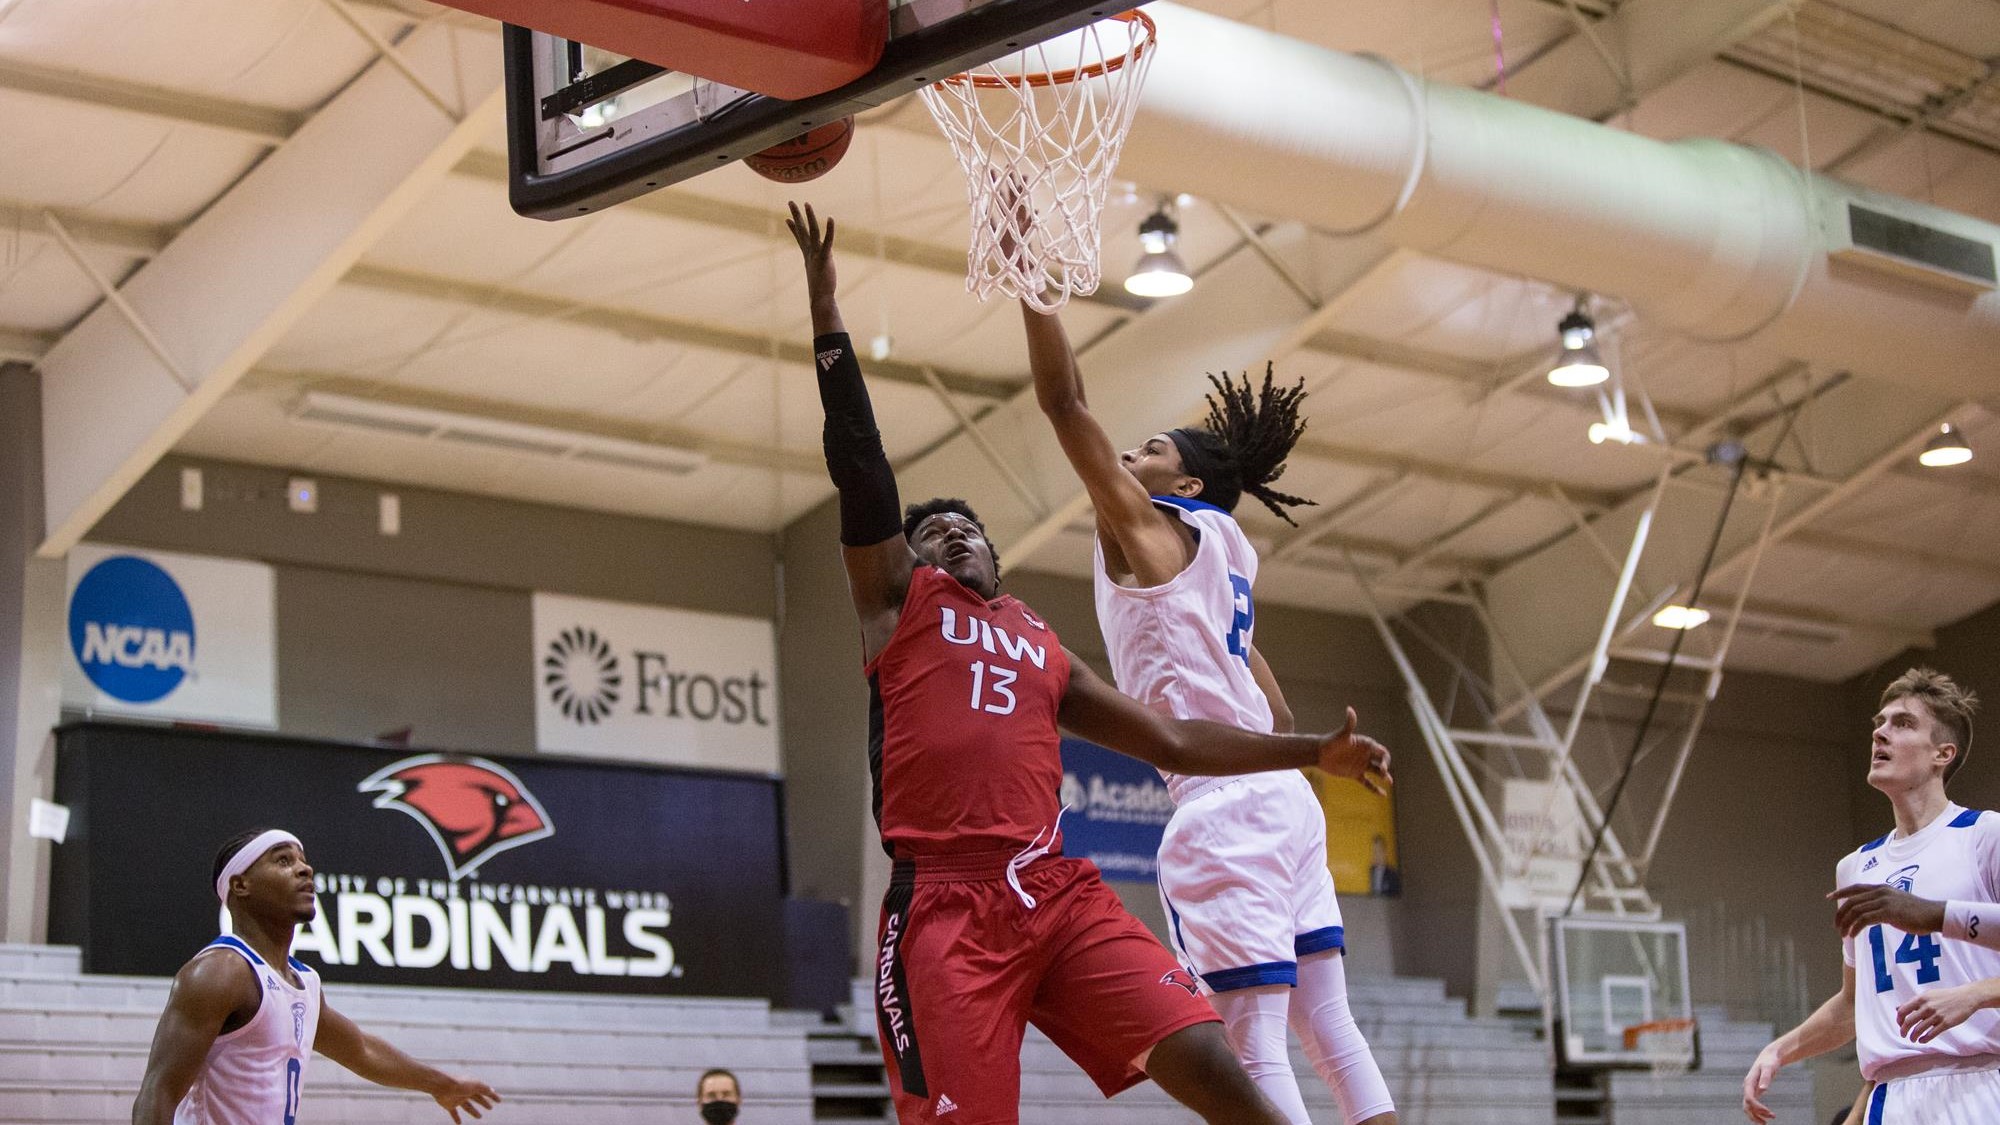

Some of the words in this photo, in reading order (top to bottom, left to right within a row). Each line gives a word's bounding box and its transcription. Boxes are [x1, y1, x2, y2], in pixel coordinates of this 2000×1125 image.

[82, 621, 193, 671] NCAA
[940, 606, 1046, 670] UIW
[633, 650, 769, 727] Frost
[970, 659, 1019, 716] 13
[1087, 774, 1176, 812] Acade
[376, 876, 407, 896] OF
[418, 878, 459, 899] THE
[219, 890, 675, 978] ARDINALS
[1869, 924, 1941, 994] 14
[880, 913, 910, 1052] CARDINALS
